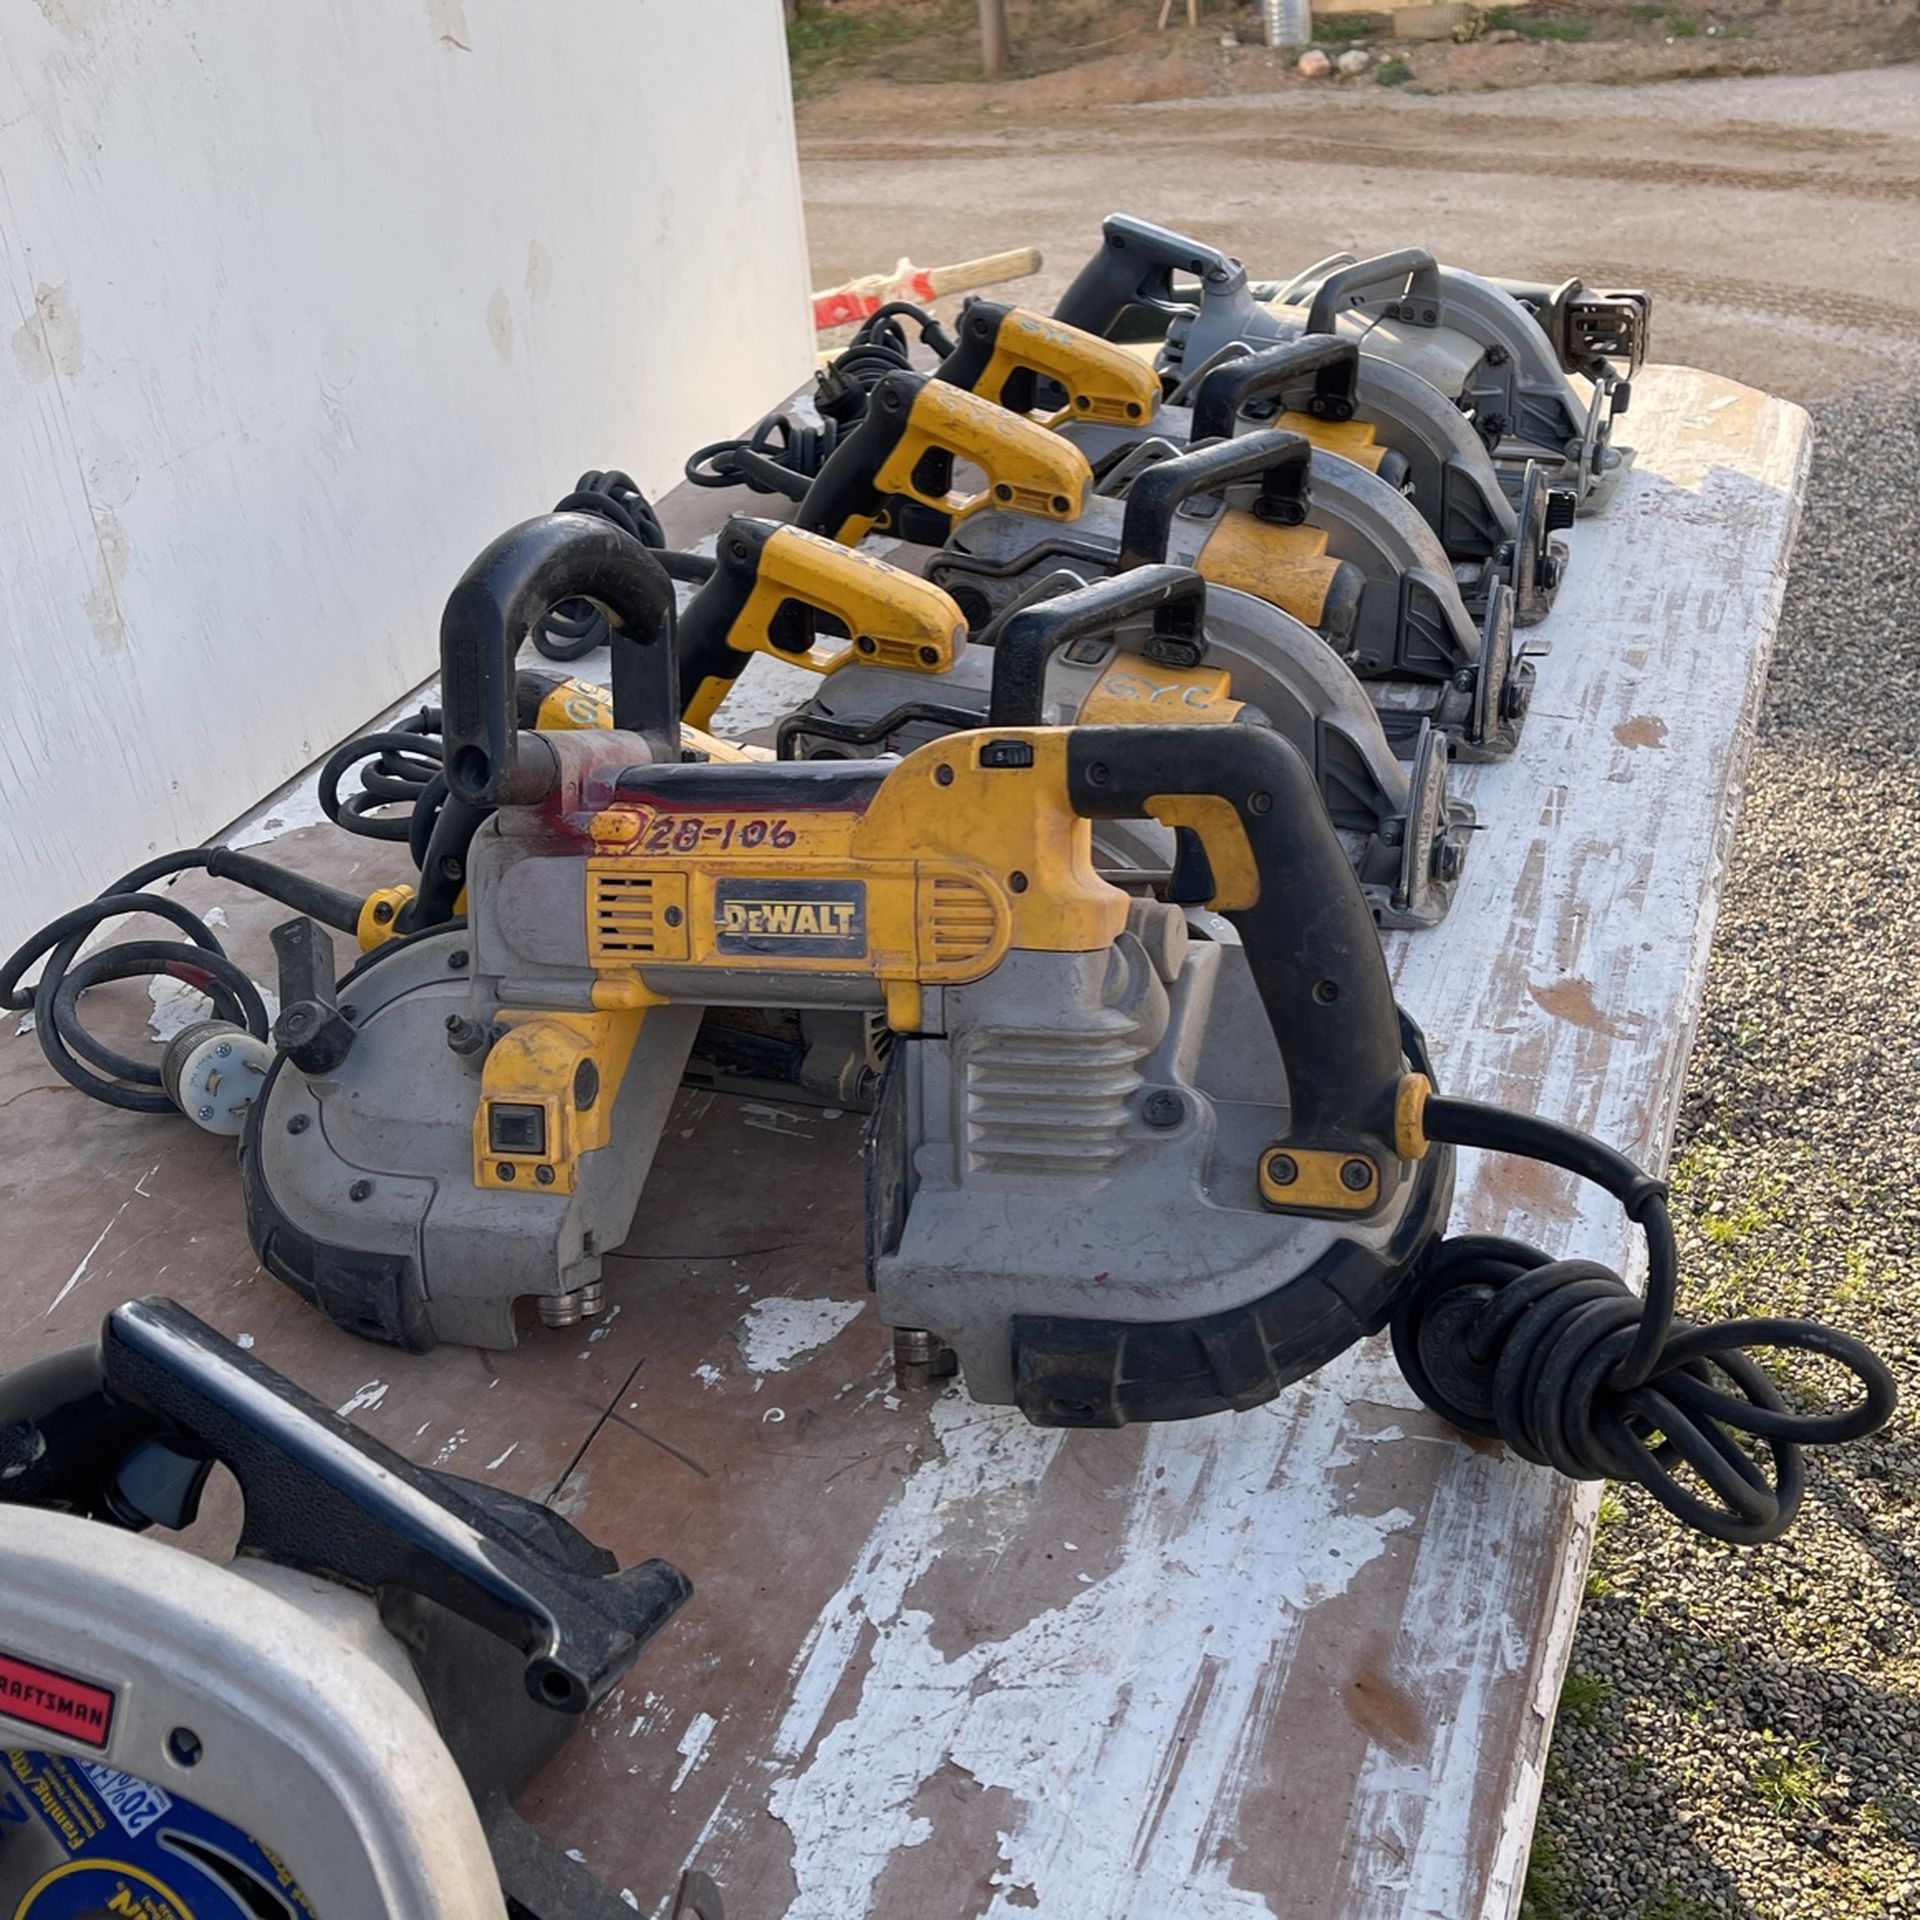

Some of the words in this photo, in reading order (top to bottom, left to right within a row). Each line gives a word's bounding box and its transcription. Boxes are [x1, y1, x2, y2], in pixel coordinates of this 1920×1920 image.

[645, 815, 797, 851] 28-106
[723, 904, 855, 934] DEWALT
[0, 1674, 103, 1727] RAFTSMAN
[107, 1772, 158, 1829] 20%
